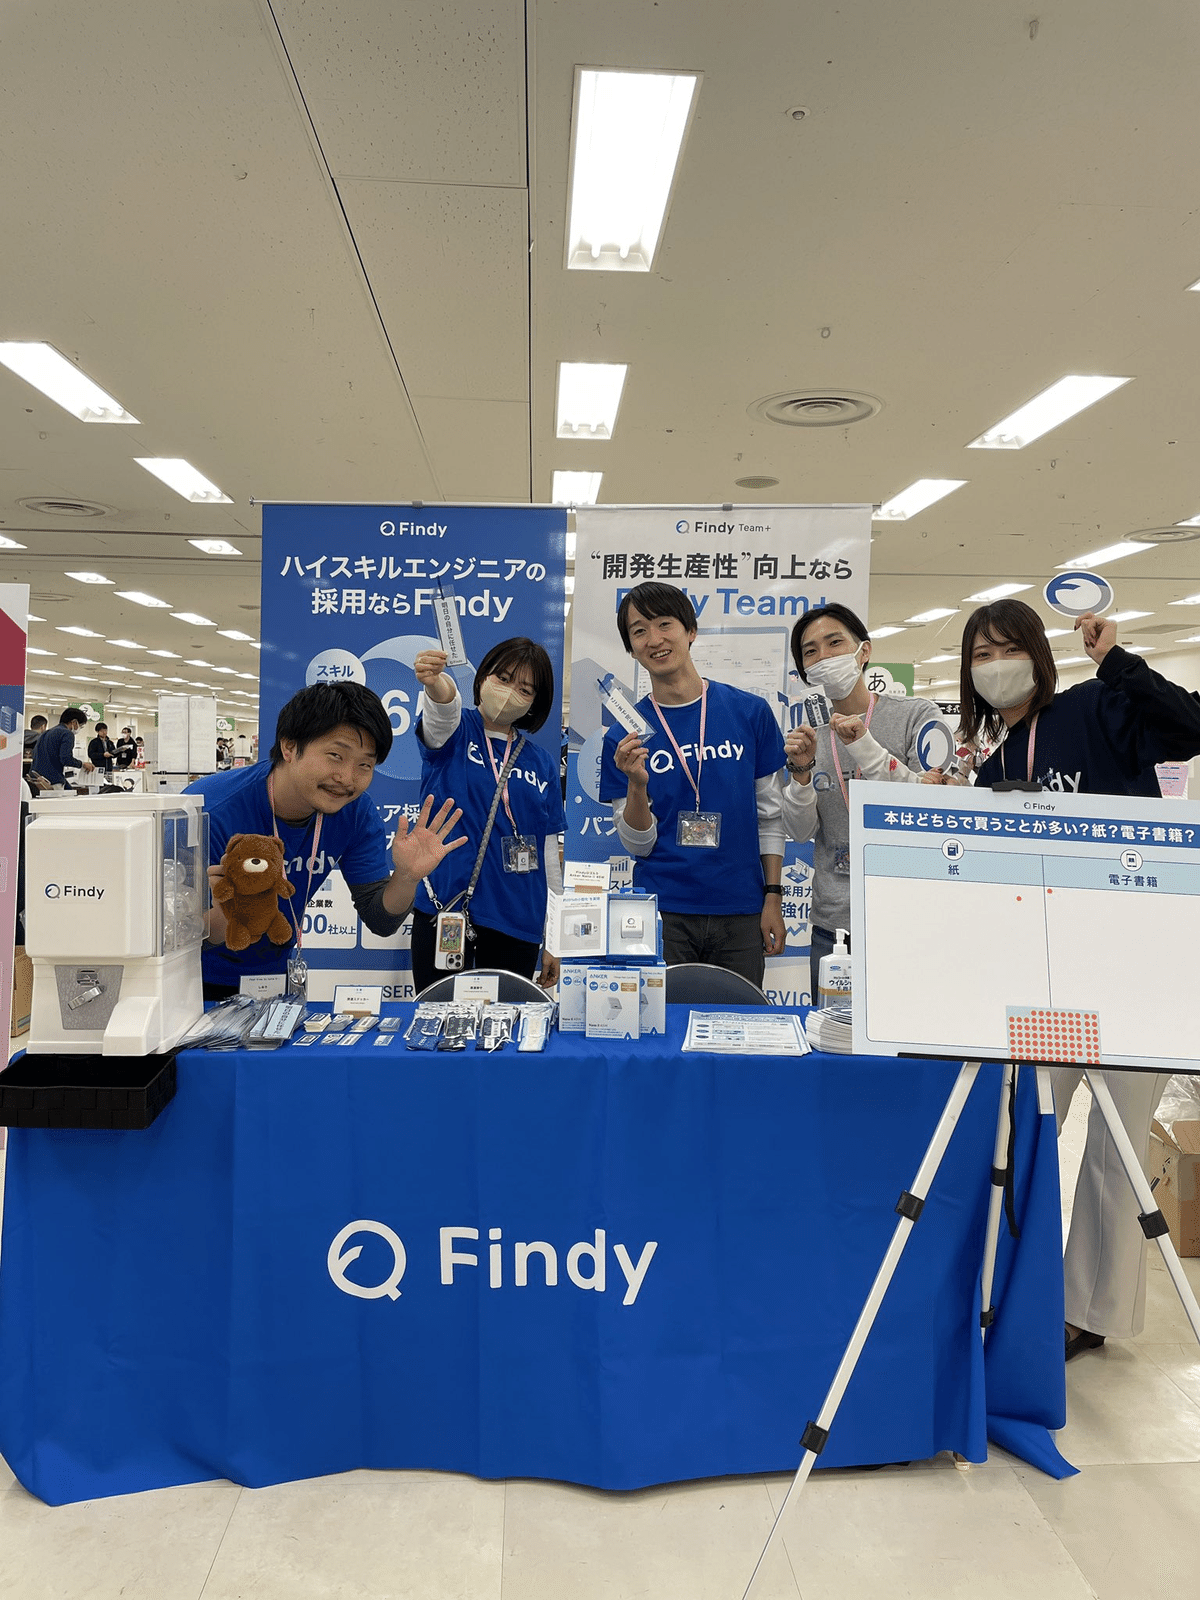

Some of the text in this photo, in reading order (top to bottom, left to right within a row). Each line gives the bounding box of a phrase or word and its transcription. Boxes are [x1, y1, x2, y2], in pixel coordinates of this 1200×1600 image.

[399, 522, 448, 538] Findy
[694, 521, 772, 535] Findy Team+
[280, 554, 546, 582] ハイスキルエンジニアの
[311, 587, 514, 623] 採用ならFndy
[317, 665, 354, 678] スキル
[868, 672, 886, 693] あ
[680, 740, 744, 761] Findy
[1032, 802, 1056, 812] Findy
[884, 810, 1195, 843] 本はどちらで買うことが多い？紙？電子書籍？
[947, 863, 960, 876] 紙
[1108, 873, 1158, 888] 電子書籍
[63, 885, 105, 900] Findy
[439, 1226, 658, 1306] Findy
